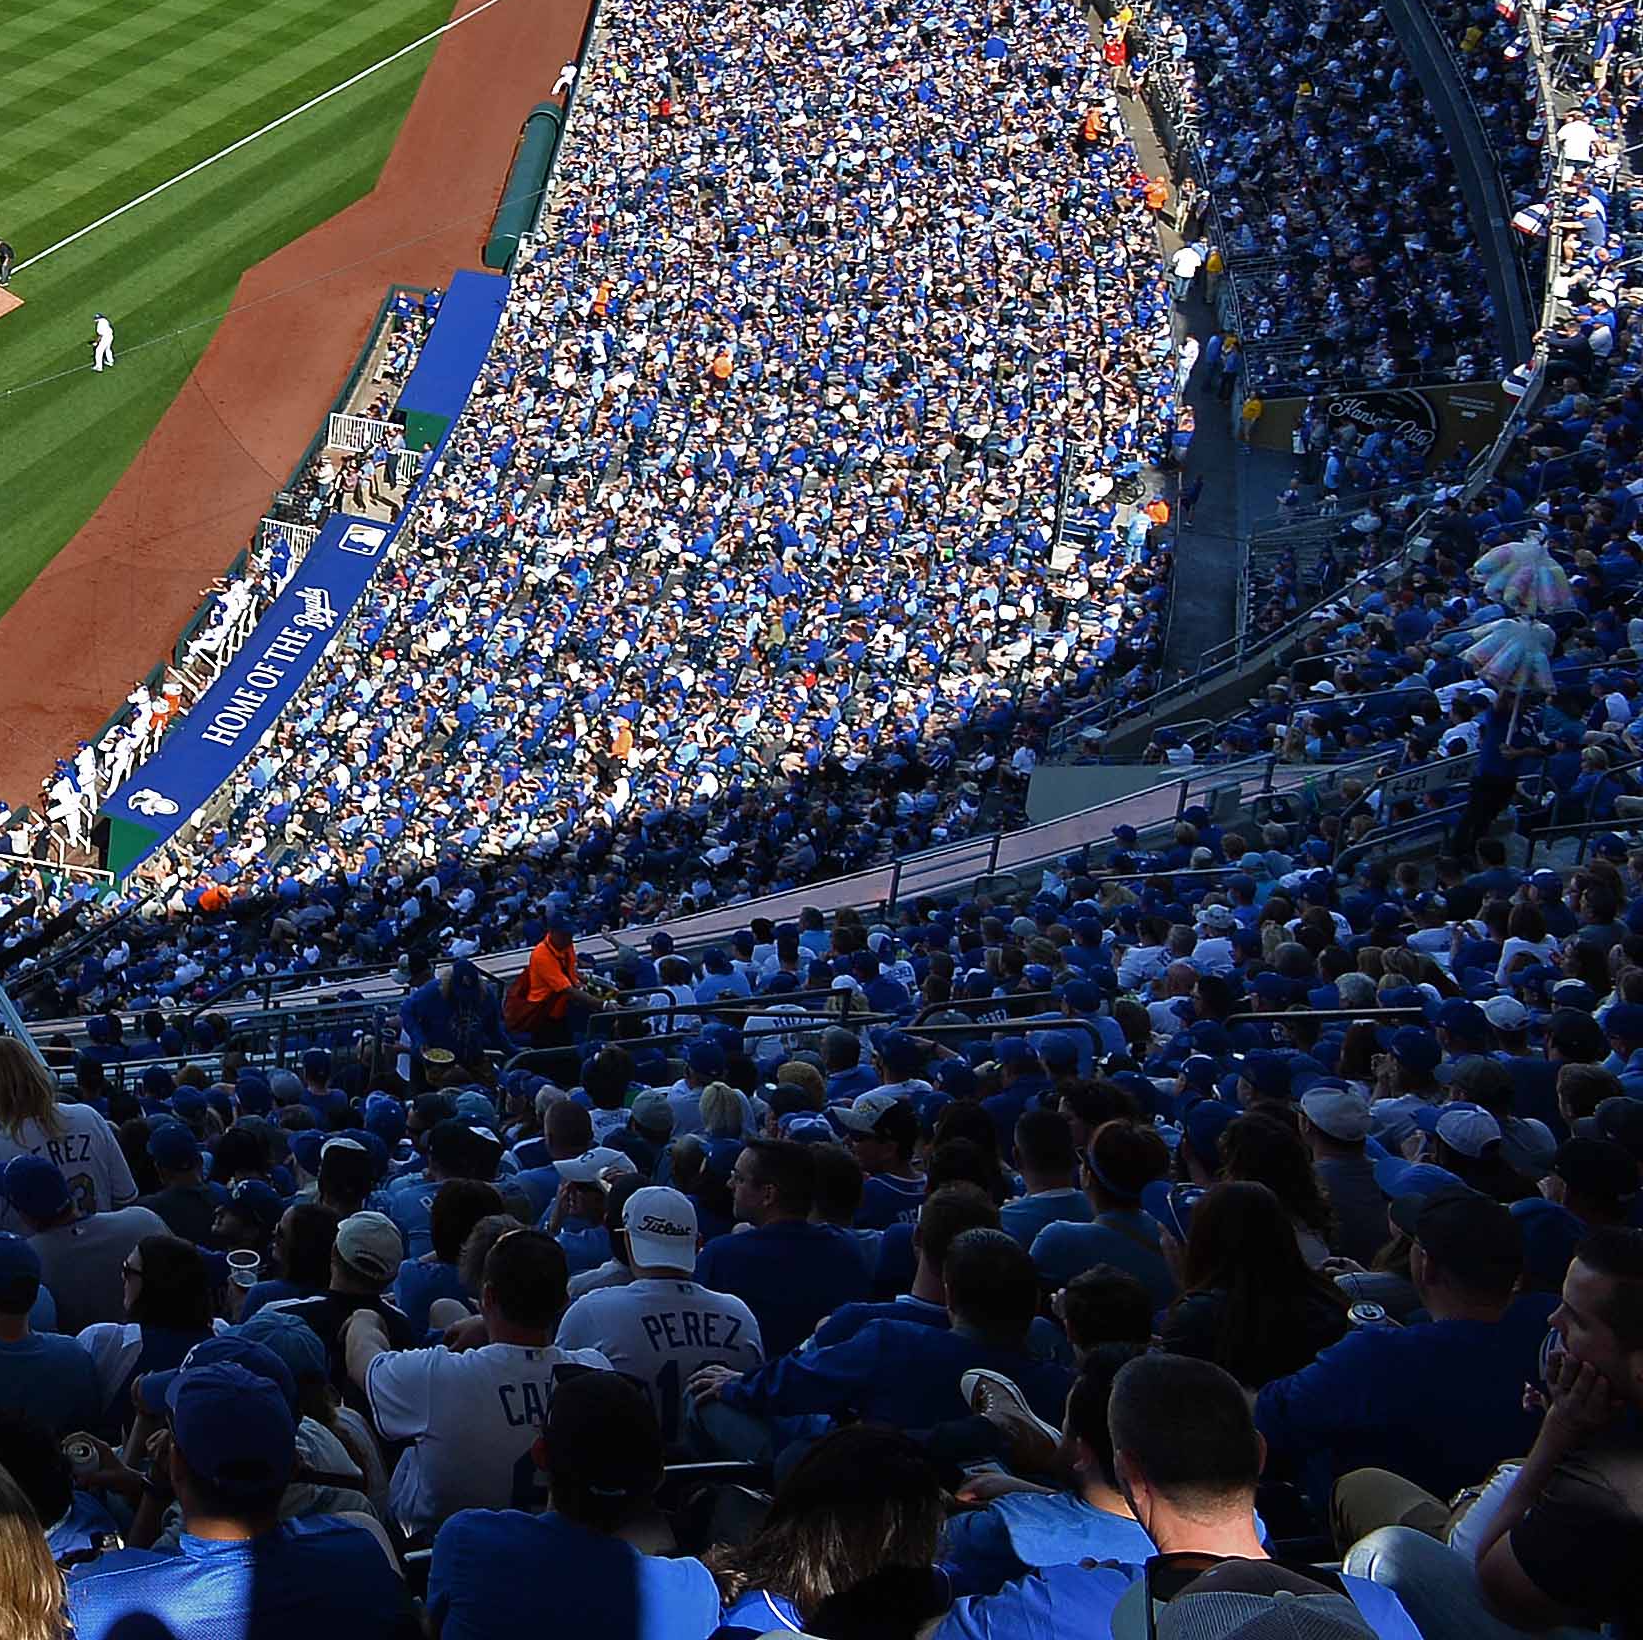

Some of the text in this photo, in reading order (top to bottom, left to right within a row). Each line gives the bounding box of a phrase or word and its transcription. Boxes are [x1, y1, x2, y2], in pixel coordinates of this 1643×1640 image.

[201, 586, 339, 747] HOME OF THE Royals
[637, 1215, 692, 1237] Titleist
[641, 1311, 743, 1353] PEREZ
